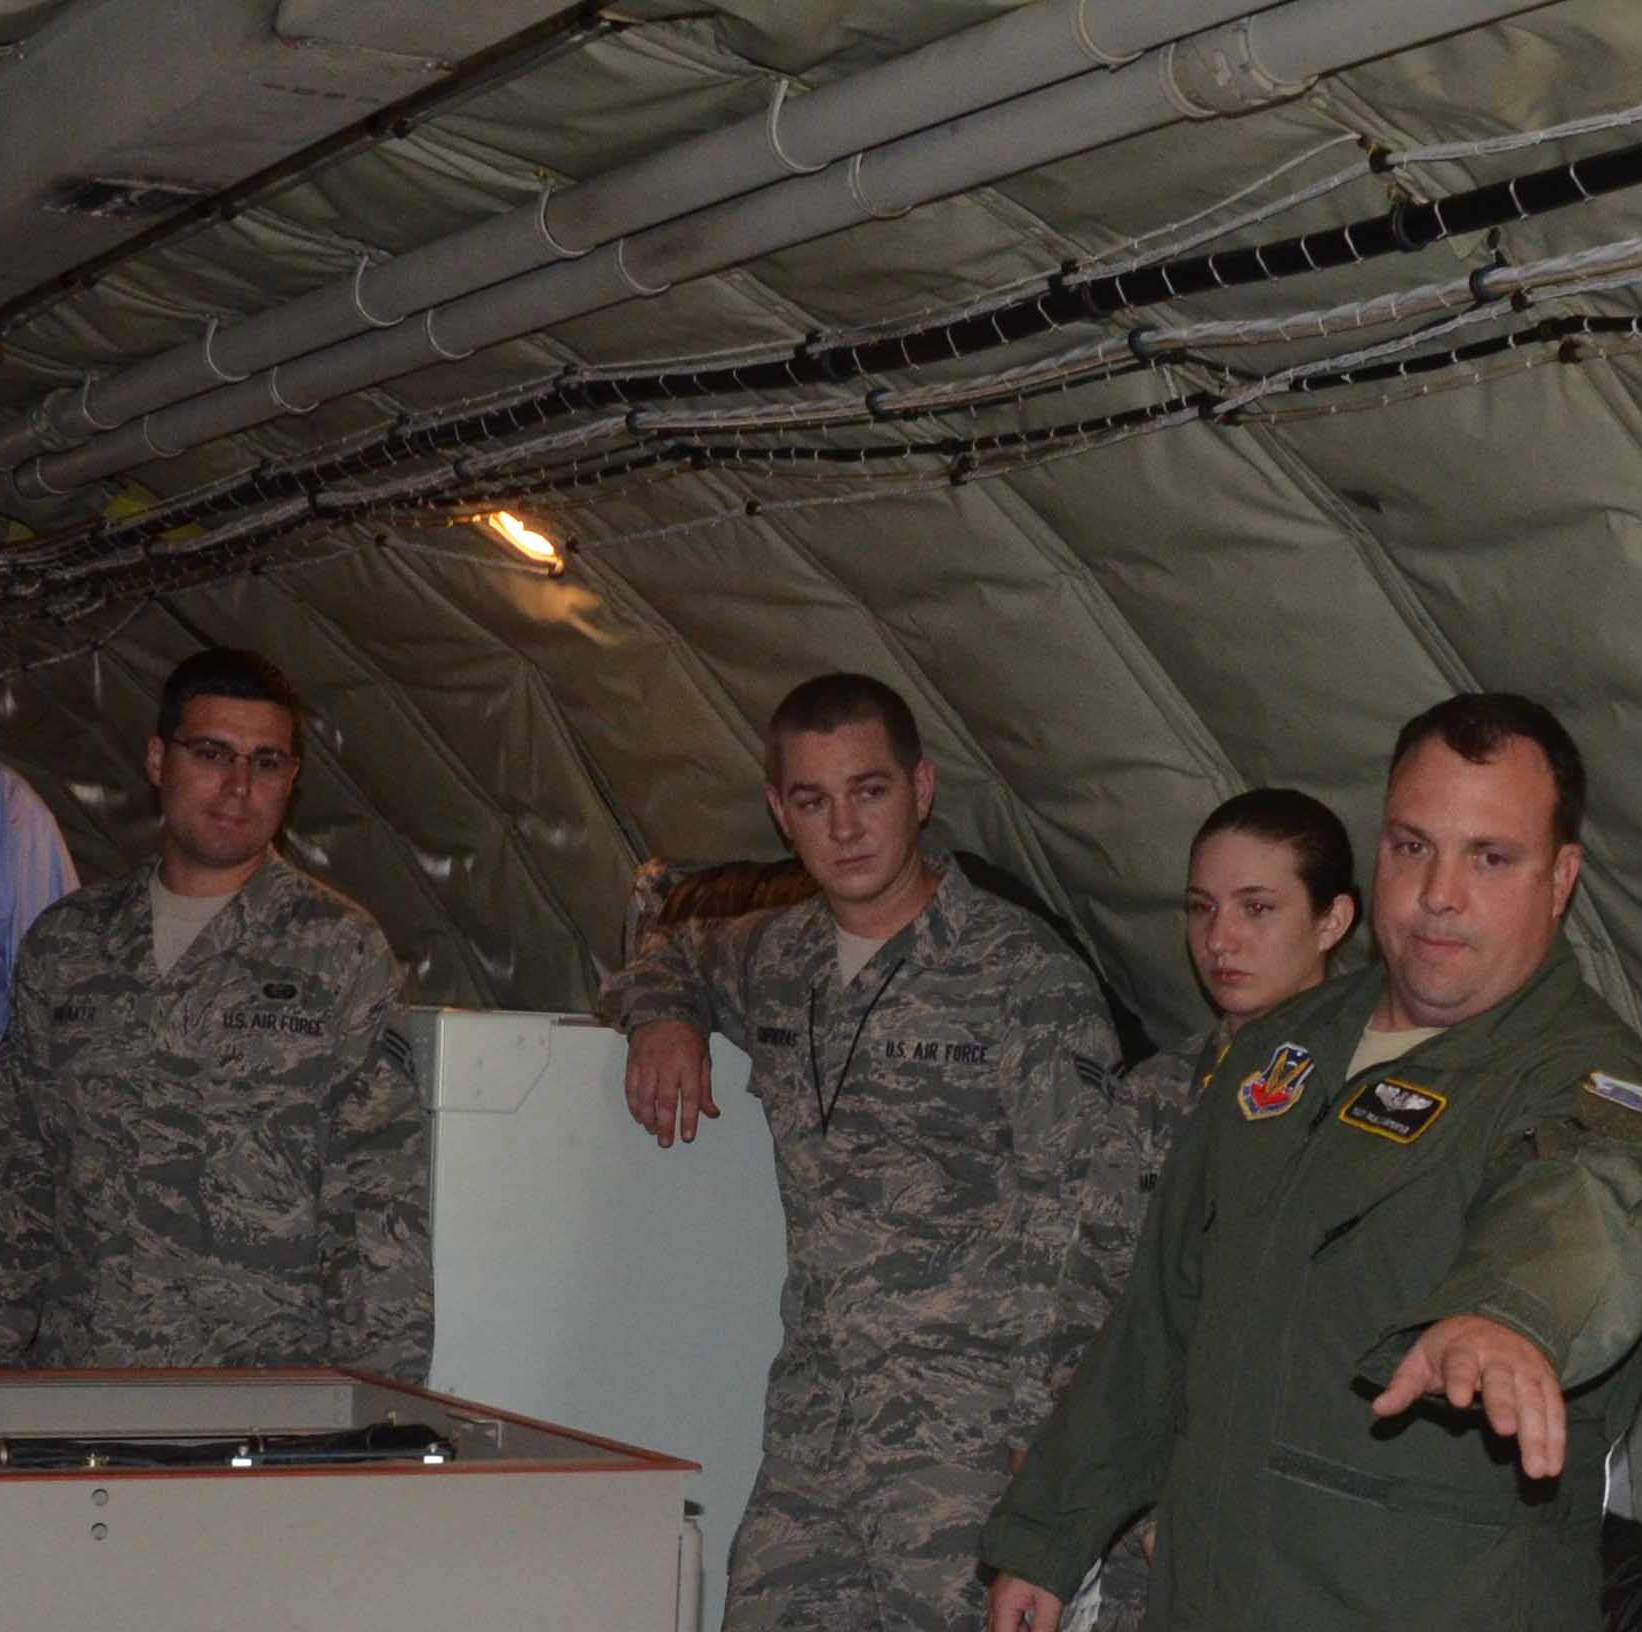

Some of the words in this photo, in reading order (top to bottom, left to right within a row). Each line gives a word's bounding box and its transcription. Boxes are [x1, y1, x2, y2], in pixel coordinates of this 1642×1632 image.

[252, 1012, 277, 1031] AIR
[281, 1014, 326, 1037] FORCE
[914, 1041, 938, 1061] AIR
[945, 1044, 989, 1063] FORCE
